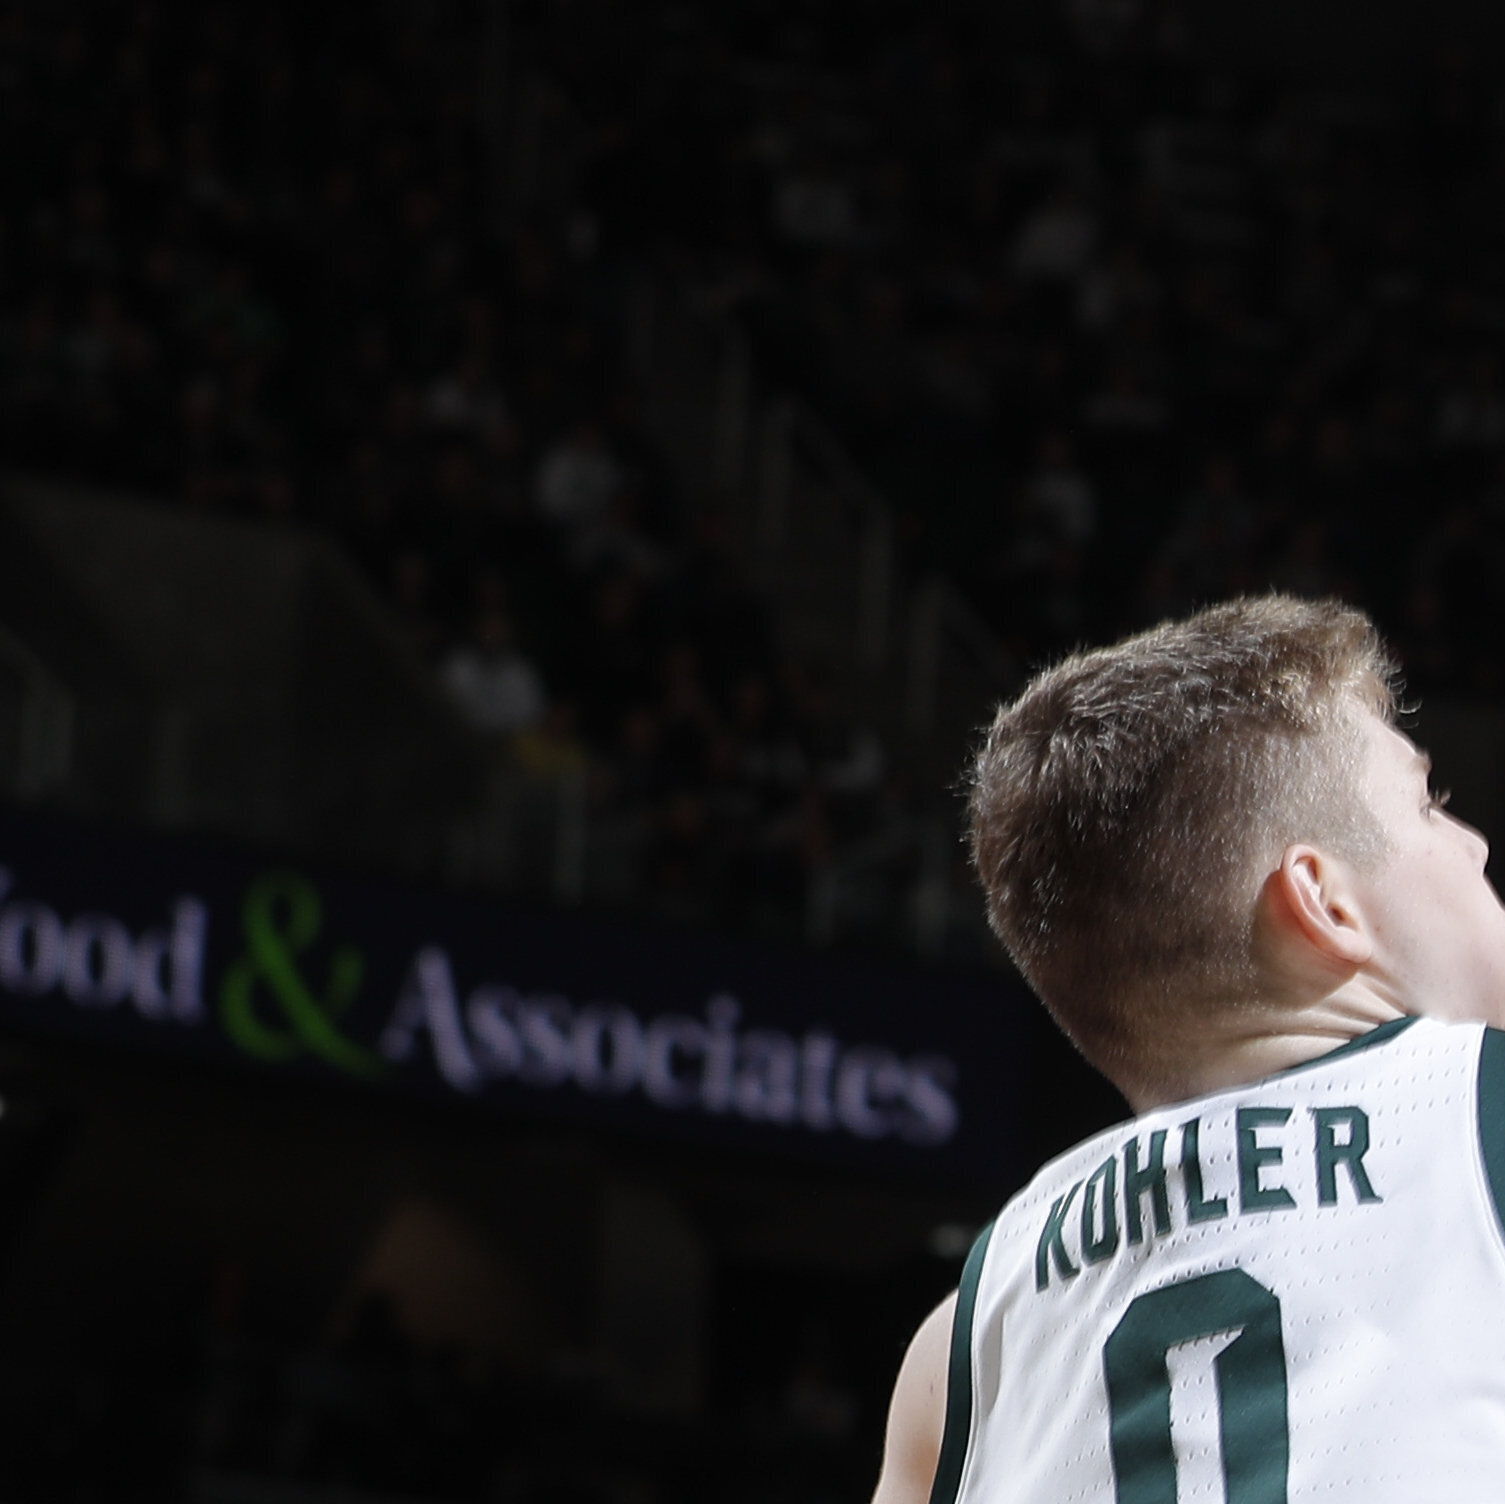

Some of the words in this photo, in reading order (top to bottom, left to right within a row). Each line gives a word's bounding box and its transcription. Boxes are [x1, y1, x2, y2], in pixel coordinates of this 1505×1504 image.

[0, 866, 207, 1025] ood
[219, 872, 388, 1081] &
[381, 946, 957, 1146] Associates
[1035, 1106, 1384, 1294] KOHLER
